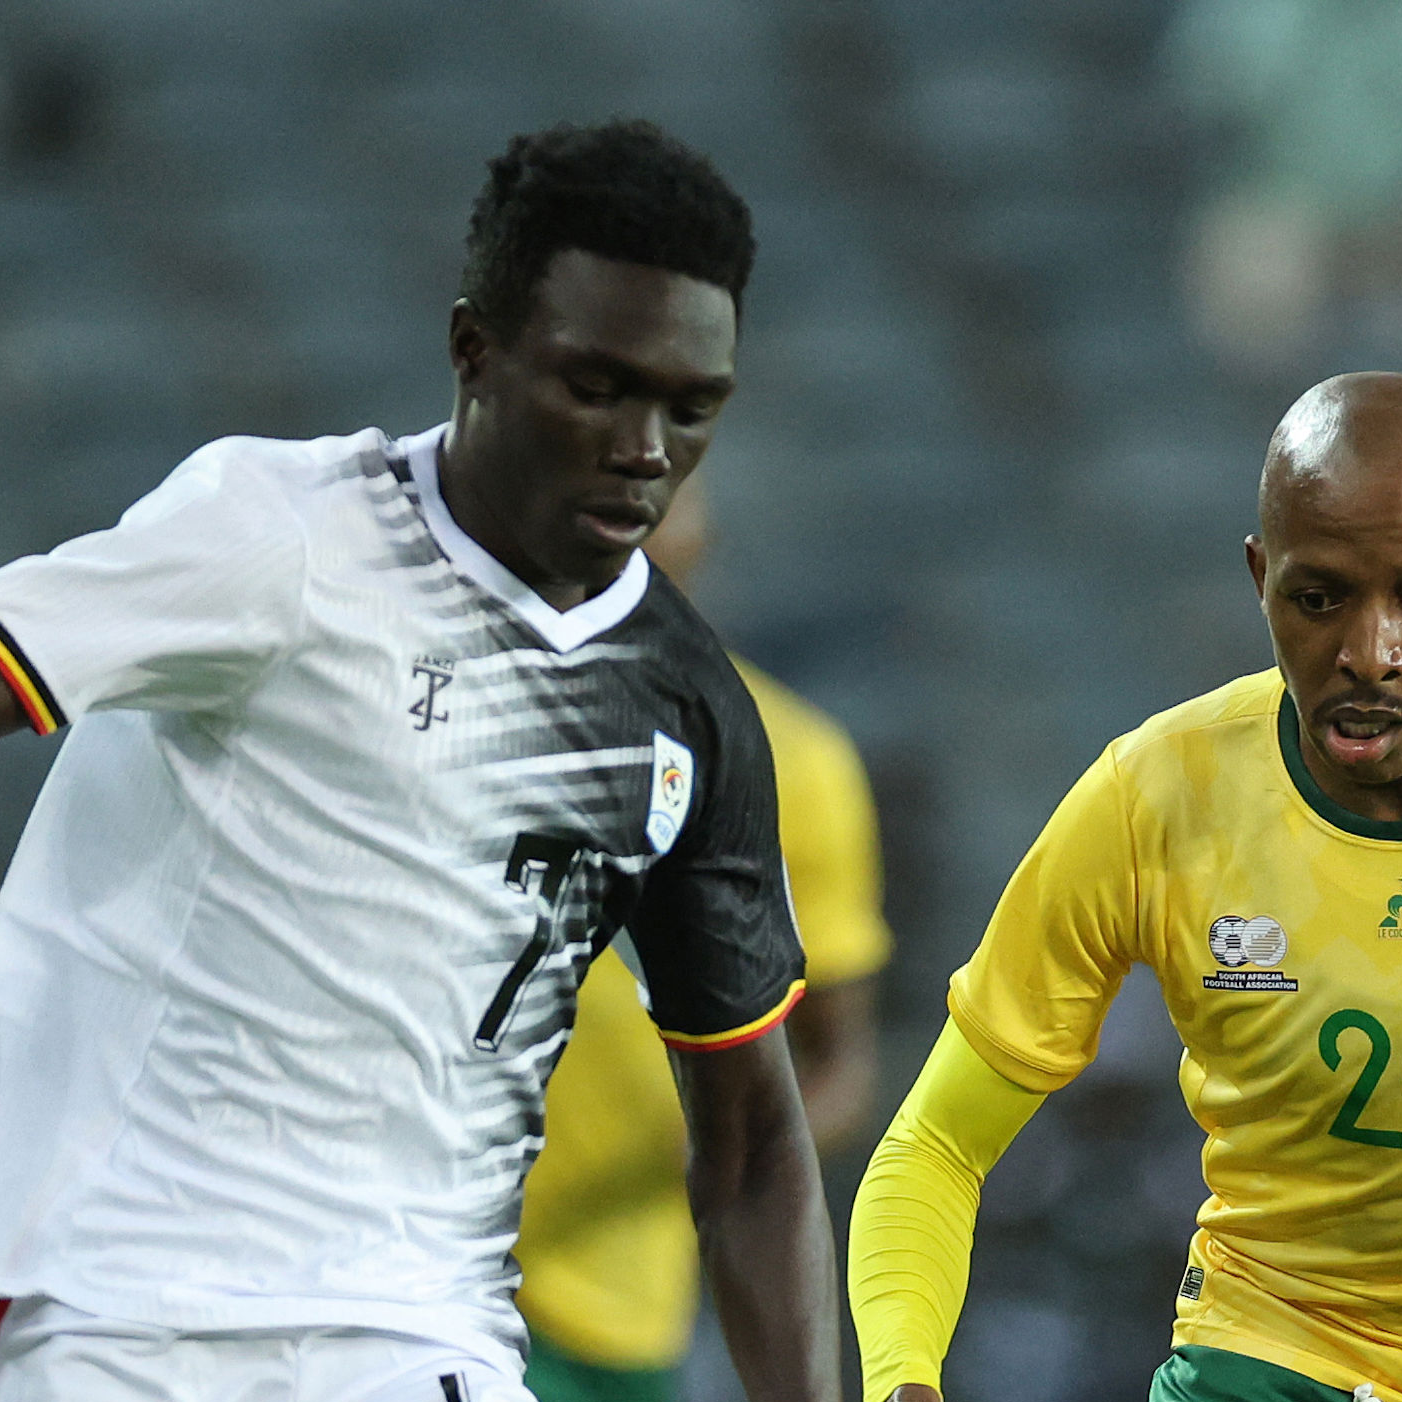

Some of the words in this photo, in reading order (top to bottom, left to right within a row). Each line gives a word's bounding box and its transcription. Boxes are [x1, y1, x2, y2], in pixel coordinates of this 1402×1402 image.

[475, 832, 584, 1052] 7
[1247, 973, 1282, 981] AFRICAN
[1204, 979, 1244, 989] FOOTBALL
[1245, 981, 1297, 990] ASSOCIATION
